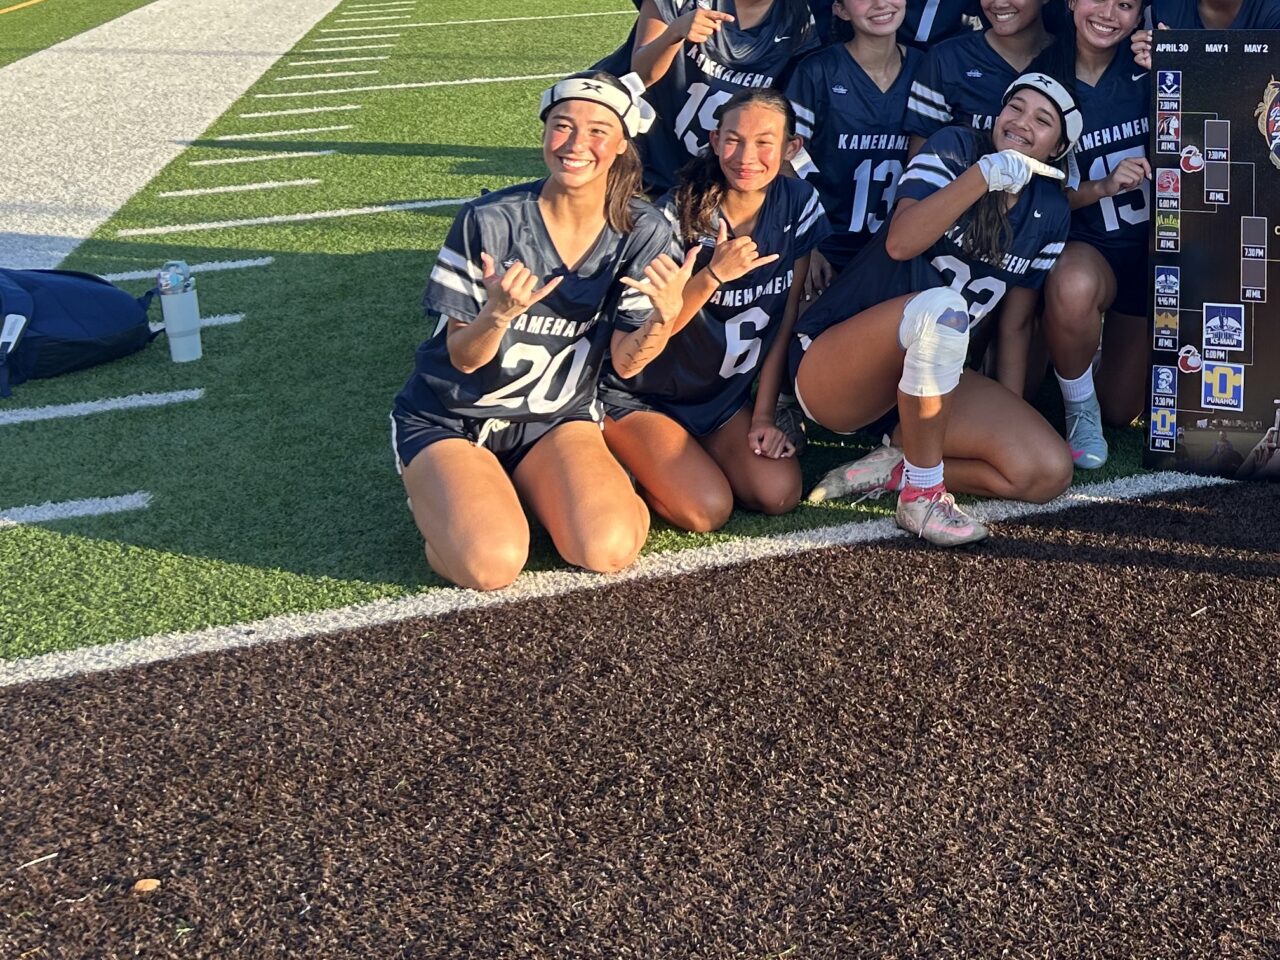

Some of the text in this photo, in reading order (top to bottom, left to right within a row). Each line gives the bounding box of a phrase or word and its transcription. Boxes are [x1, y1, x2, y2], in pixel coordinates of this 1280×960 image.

[1156, 44, 1188, 52] APRIL 30
[1205, 44, 1222, 52] MAY
[1244, 44, 1268, 53] MAY 2
[1075, 117, 1150, 154] AMEHAMEH
[1217, 151, 1226, 160] PM
[848, 159, 904, 234] 13
[1170, 200, 1178, 208] PM
[1255, 248, 1264, 257] PM
[719, 306, 770, 379] 6
[1217, 351, 1225, 360] PM
[473, 337, 591, 414] 20
[1166, 398, 1174, 406] PM
[1206, 396, 1238, 406] PUNAHOU
